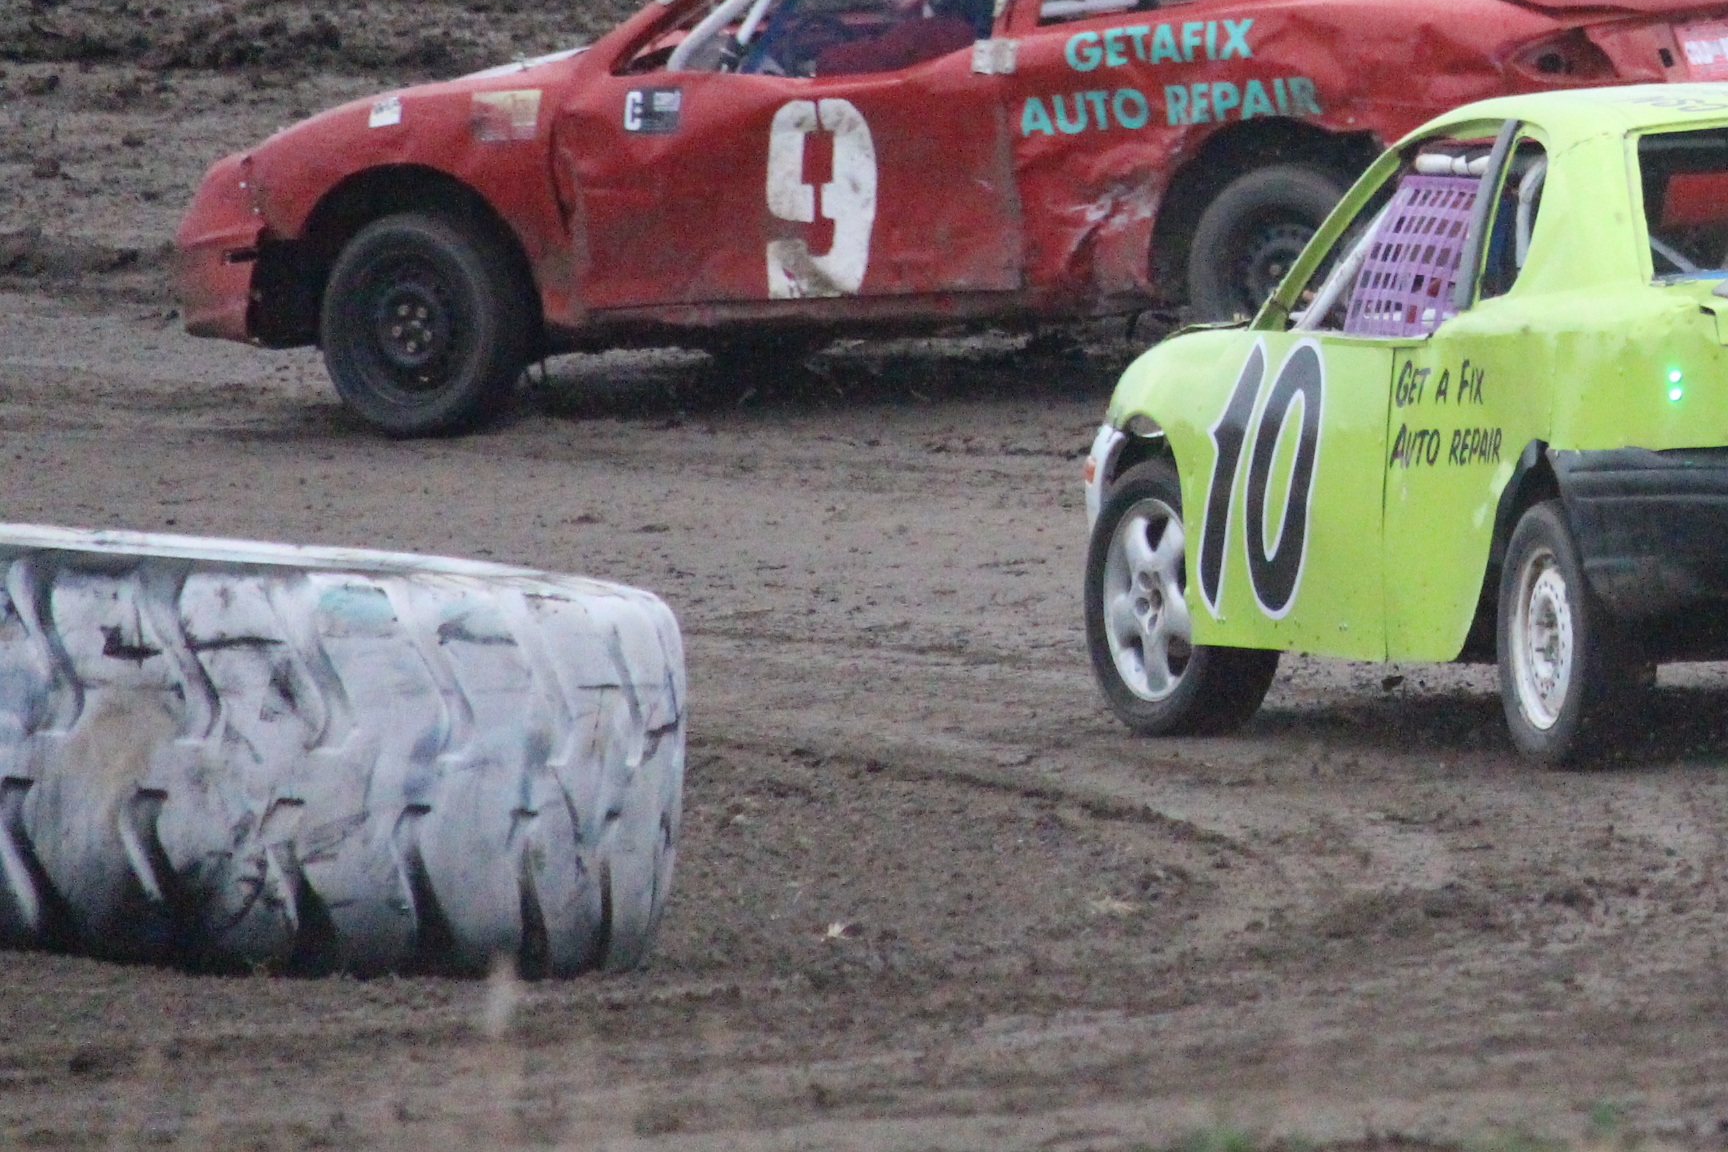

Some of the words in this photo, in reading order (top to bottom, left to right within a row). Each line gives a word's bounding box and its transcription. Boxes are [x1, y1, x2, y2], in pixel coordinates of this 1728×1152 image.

[1065, 18, 1254, 72] GETAFIX
[1020, 88, 1150, 137] AUTO
[1163, 76, 1321, 126] REPAIR
[765, 97, 878, 299] 9
[1389, 422, 1441, 469] AUTO
[1448, 427, 1503, 466] REPAIR
[1197, 336, 1325, 620] 10
